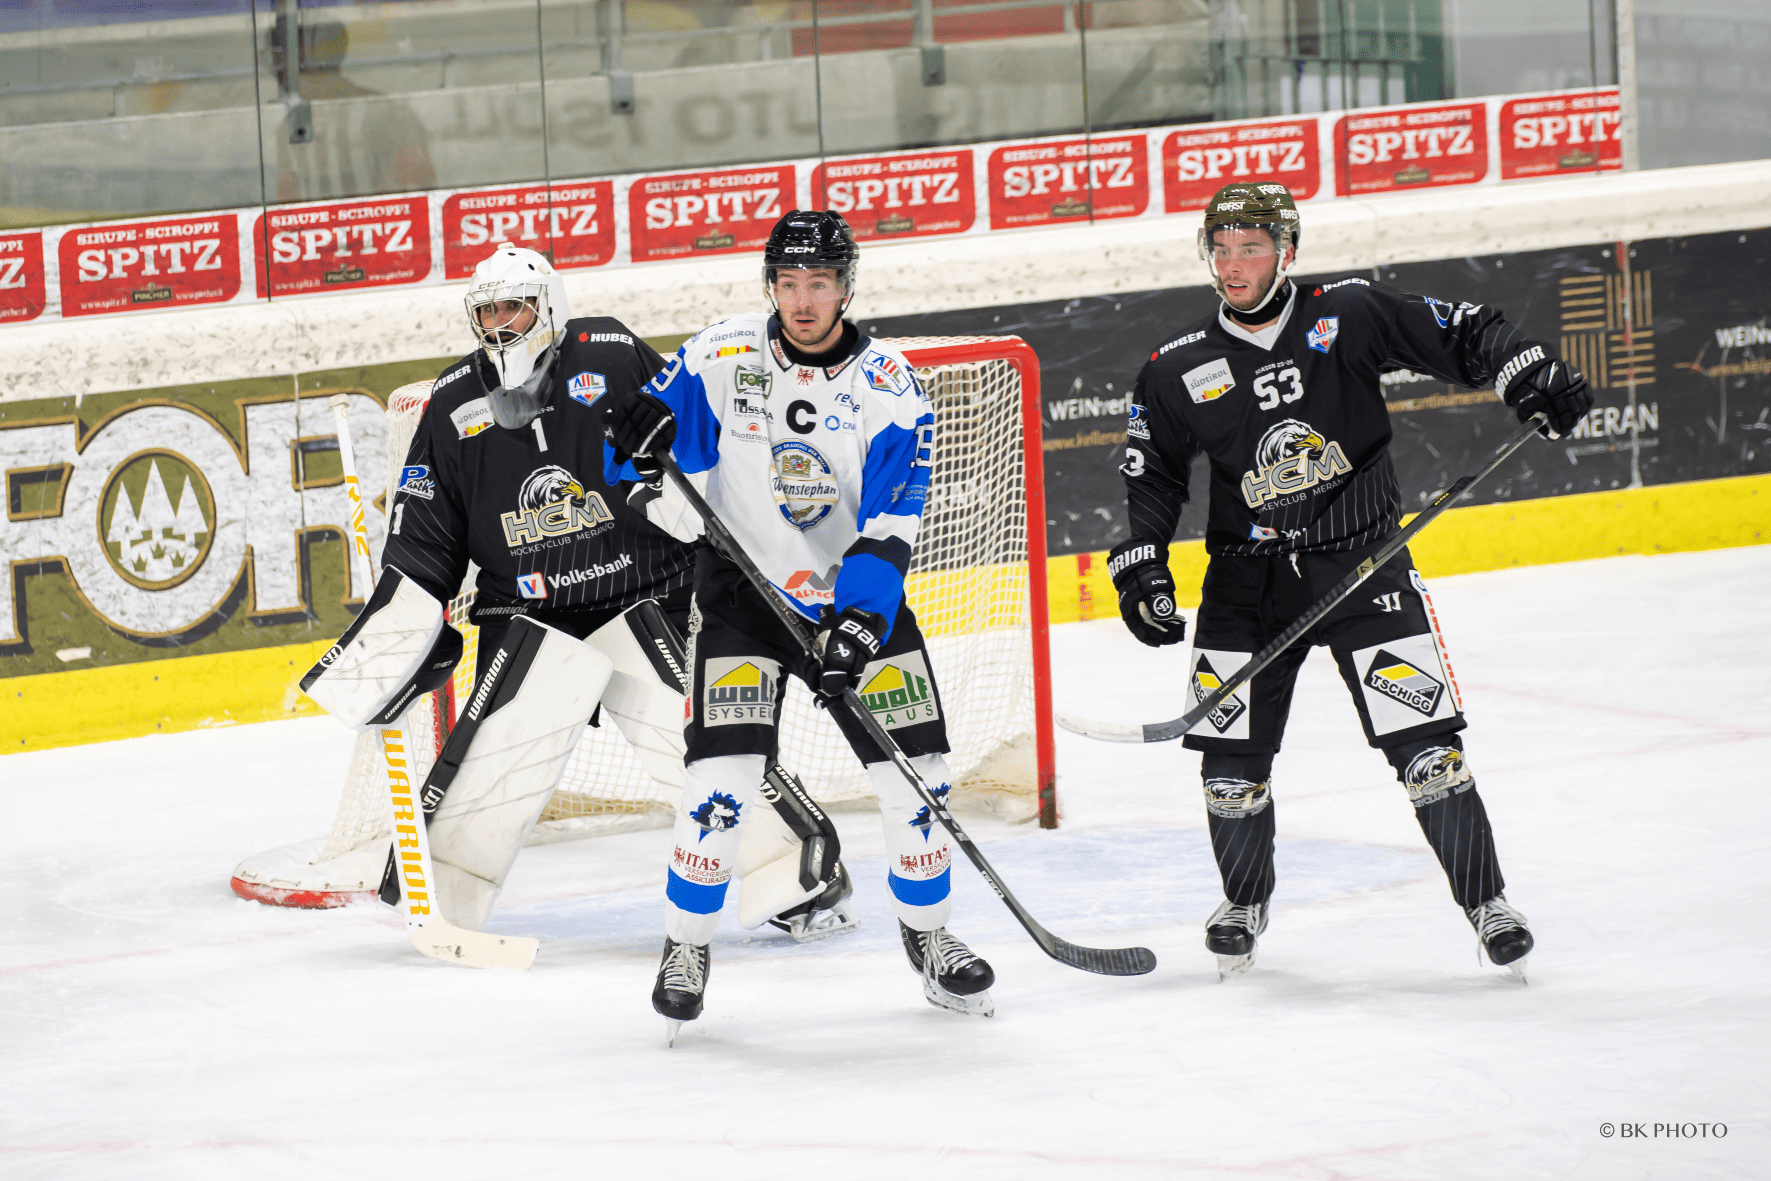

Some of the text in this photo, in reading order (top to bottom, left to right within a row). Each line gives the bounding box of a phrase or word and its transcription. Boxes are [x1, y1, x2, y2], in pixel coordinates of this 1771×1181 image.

[1177, 141, 1306, 182] SPITZ
[1348, 125, 1475, 165] SPITZ
[645, 178, 702, 194] SIRUPE
[827, 172, 960, 213] SPITZ
[1003, 157, 1134, 198] SPITZ
[271, 204, 411, 227] SIRUPE SCIROPPI
[459, 188, 597, 210] SIRUPE SCIROPPI
[645, 187, 782, 230] SPITZ
[77, 222, 219, 246] SIRUPE SCIROPPI
[272, 220, 413, 264] SPITZ
[460, 204, 599, 247] SPITZ
[78, 239, 222, 282] SPITZ
[784, 246, 816, 254] CCM
[135, 289, 169, 300] PIRCHER
[1160, 330, 1207, 355] HUBER
[1253, 366, 1304, 411] 53
[531, 417, 549, 453] 1
[785, 399, 818, 435] C
[1241, 441, 1353, 509] HCM
[500, 491, 615, 547] HCM
[510, 536, 572, 557] HOCKEYCLUB
[547, 553, 634, 590] Volksbank
[384, 683, 418, 720] WARRIOR
[467, 648, 509, 721] WARRIOR
[860, 669, 928, 712] wolf
[1372, 674, 1432, 712] TSCHIGG
[775, 764, 824, 821] WARRIOR
[381, 729, 431, 916] WARRIOR
[685, 852, 721, 872] ITAS
[981, 870, 1005, 899] CCM
